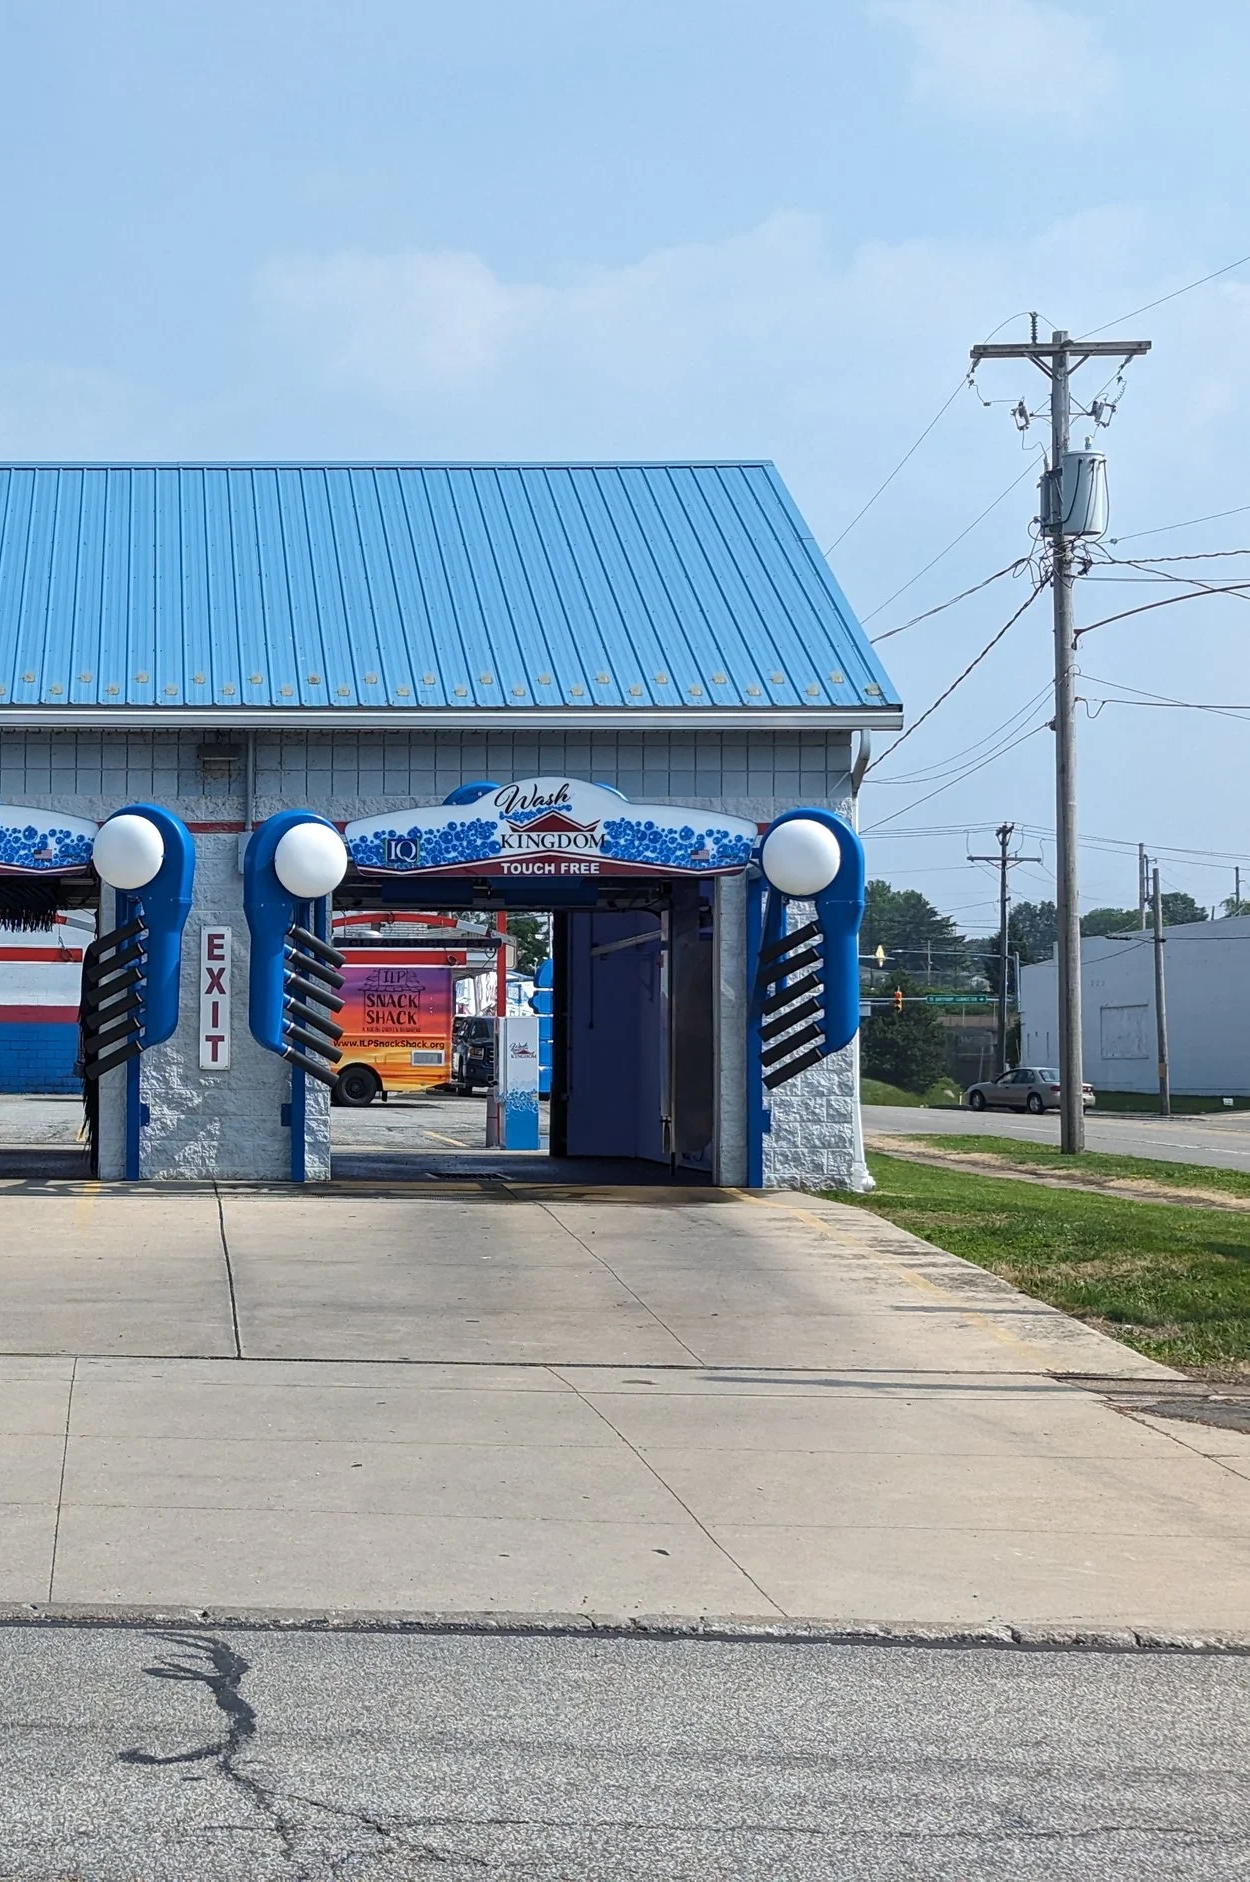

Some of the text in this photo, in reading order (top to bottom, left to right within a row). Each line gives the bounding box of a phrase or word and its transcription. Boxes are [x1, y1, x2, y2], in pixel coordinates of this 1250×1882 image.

[494, 783, 571, 815] Wash
[500, 833, 607, 849] KINGDOM
[389, 840, 417, 863] IQ
[501, 863, 600, 875] TOUCH FREE
[383, 970, 406, 984] ILP
[204, 933, 227, 1062] EXIT
[366, 993, 418, 1009] SNACK
[366, 1009, 417, 1026] SHACK
